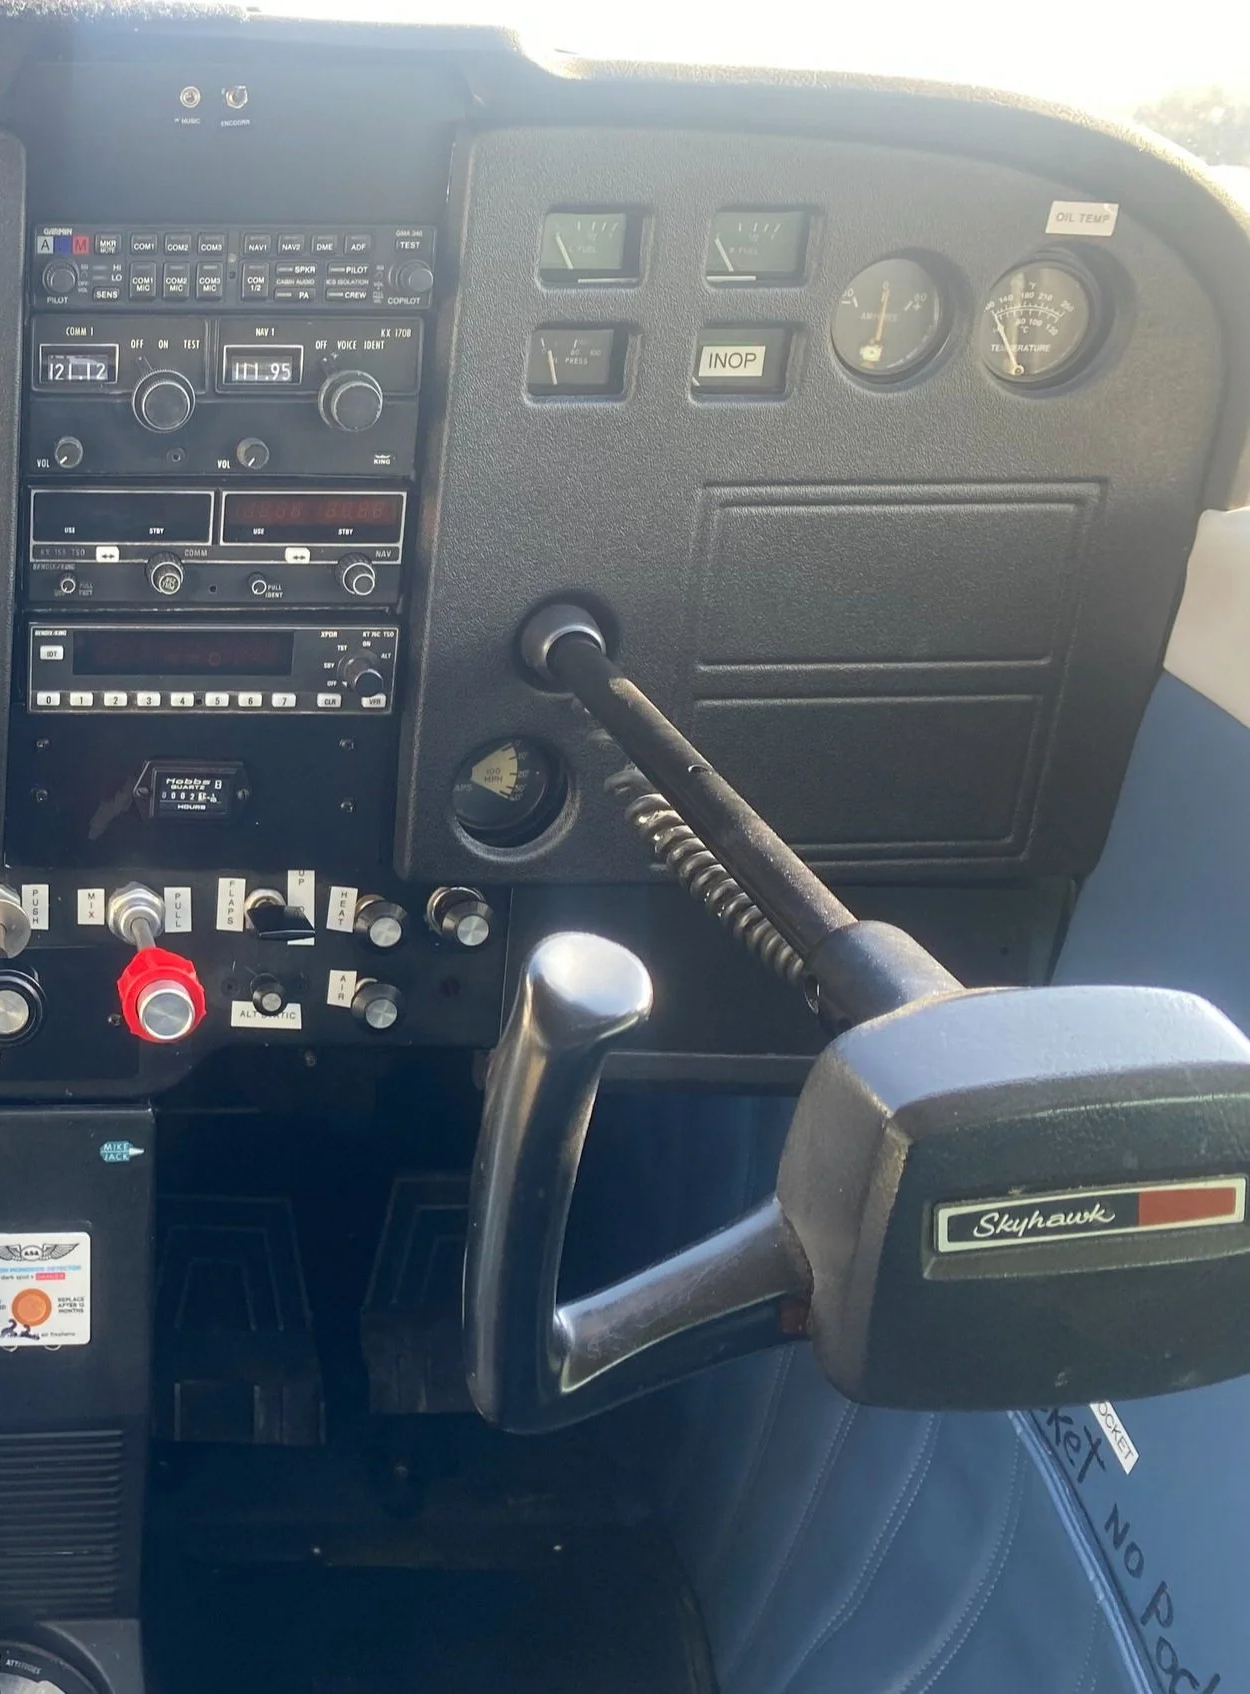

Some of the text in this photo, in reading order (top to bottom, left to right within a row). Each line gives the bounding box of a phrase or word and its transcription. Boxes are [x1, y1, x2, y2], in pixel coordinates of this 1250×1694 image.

[1056, 212, 1110, 224] OIL TEMP
[66, 327, 87, 336] COMM
[256, 328, 269, 336] NAV
[381, 329, 390, 337] KX
[131, 340, 143, 349] OFF
[184, 340, 200, 349] TEST
[316, 341, 327, 350] OFF
[337, 341, 357, 350] VOICE
[364, 341, 385, 350] IDENT
[708, 353, 757, 369] INOP
[37, 459, 49, 468] VOL
[218, 460, 230, 468] VOL
[375, 550, 392, 558] NAV
[46, 696, 52, 704] 0
[227, 881, 235, 925] FLAPS
[338, 891, 348, 926] HEAT
[338, 975, 346, 1000] AIR
[103, 1143, 129, 1151] MIKE
[973, 1203, 1116, 1239] Skyhawk
[1099, 1402, 1134, 1461] OCKET
[6, 1658, 43, 1675] ATTITUDES
